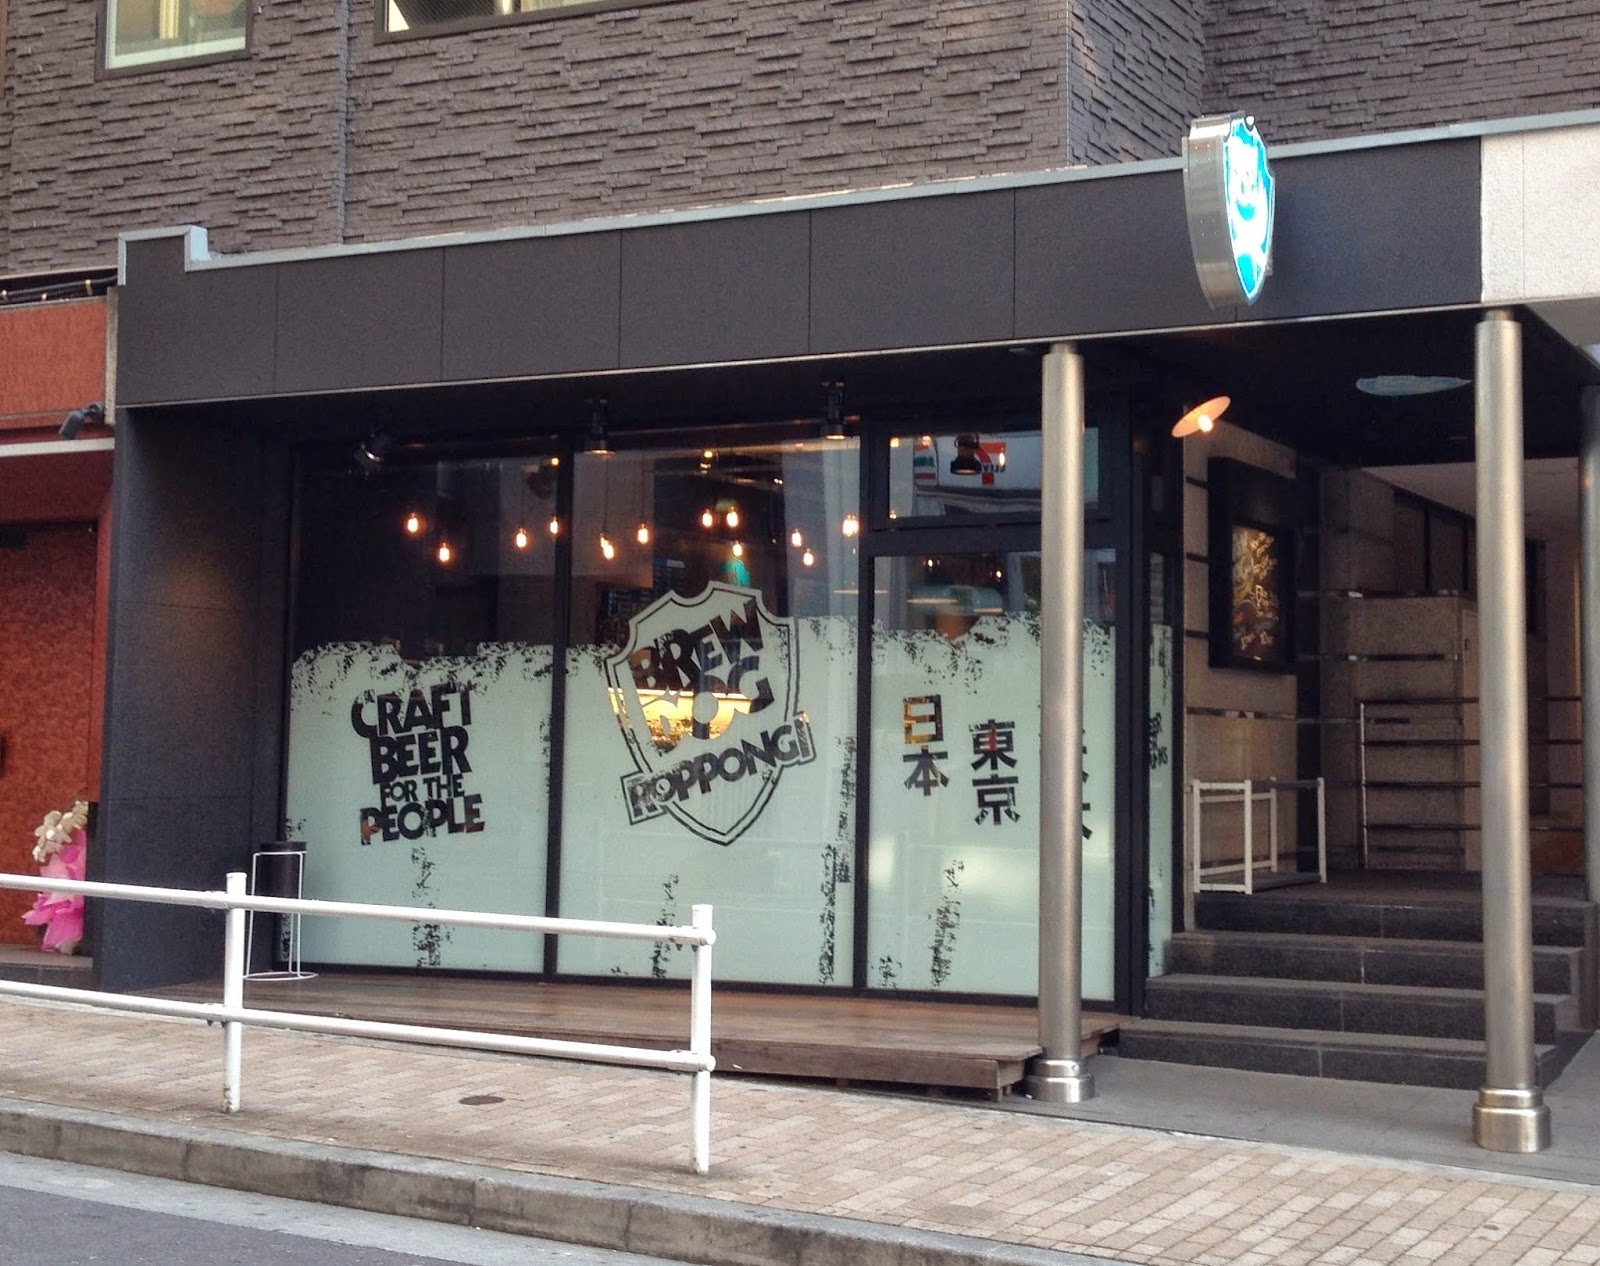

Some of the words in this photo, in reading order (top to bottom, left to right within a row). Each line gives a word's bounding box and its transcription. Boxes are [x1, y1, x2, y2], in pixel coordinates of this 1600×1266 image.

[627, 599, 764, 693] BREW
[350, 682, 475, 739] CRAFT
[902, 694, 949, 797] 日本
[369, 725, 472, 785] BEER
[380, 781, 418, 807] FOR
[423, 773, 466, 800] THE
[627, 716, 812, 818] ROPPONGI
[969, 719, 1021, 826] 東京
[360, 794, 485, 845] PEOPLE
